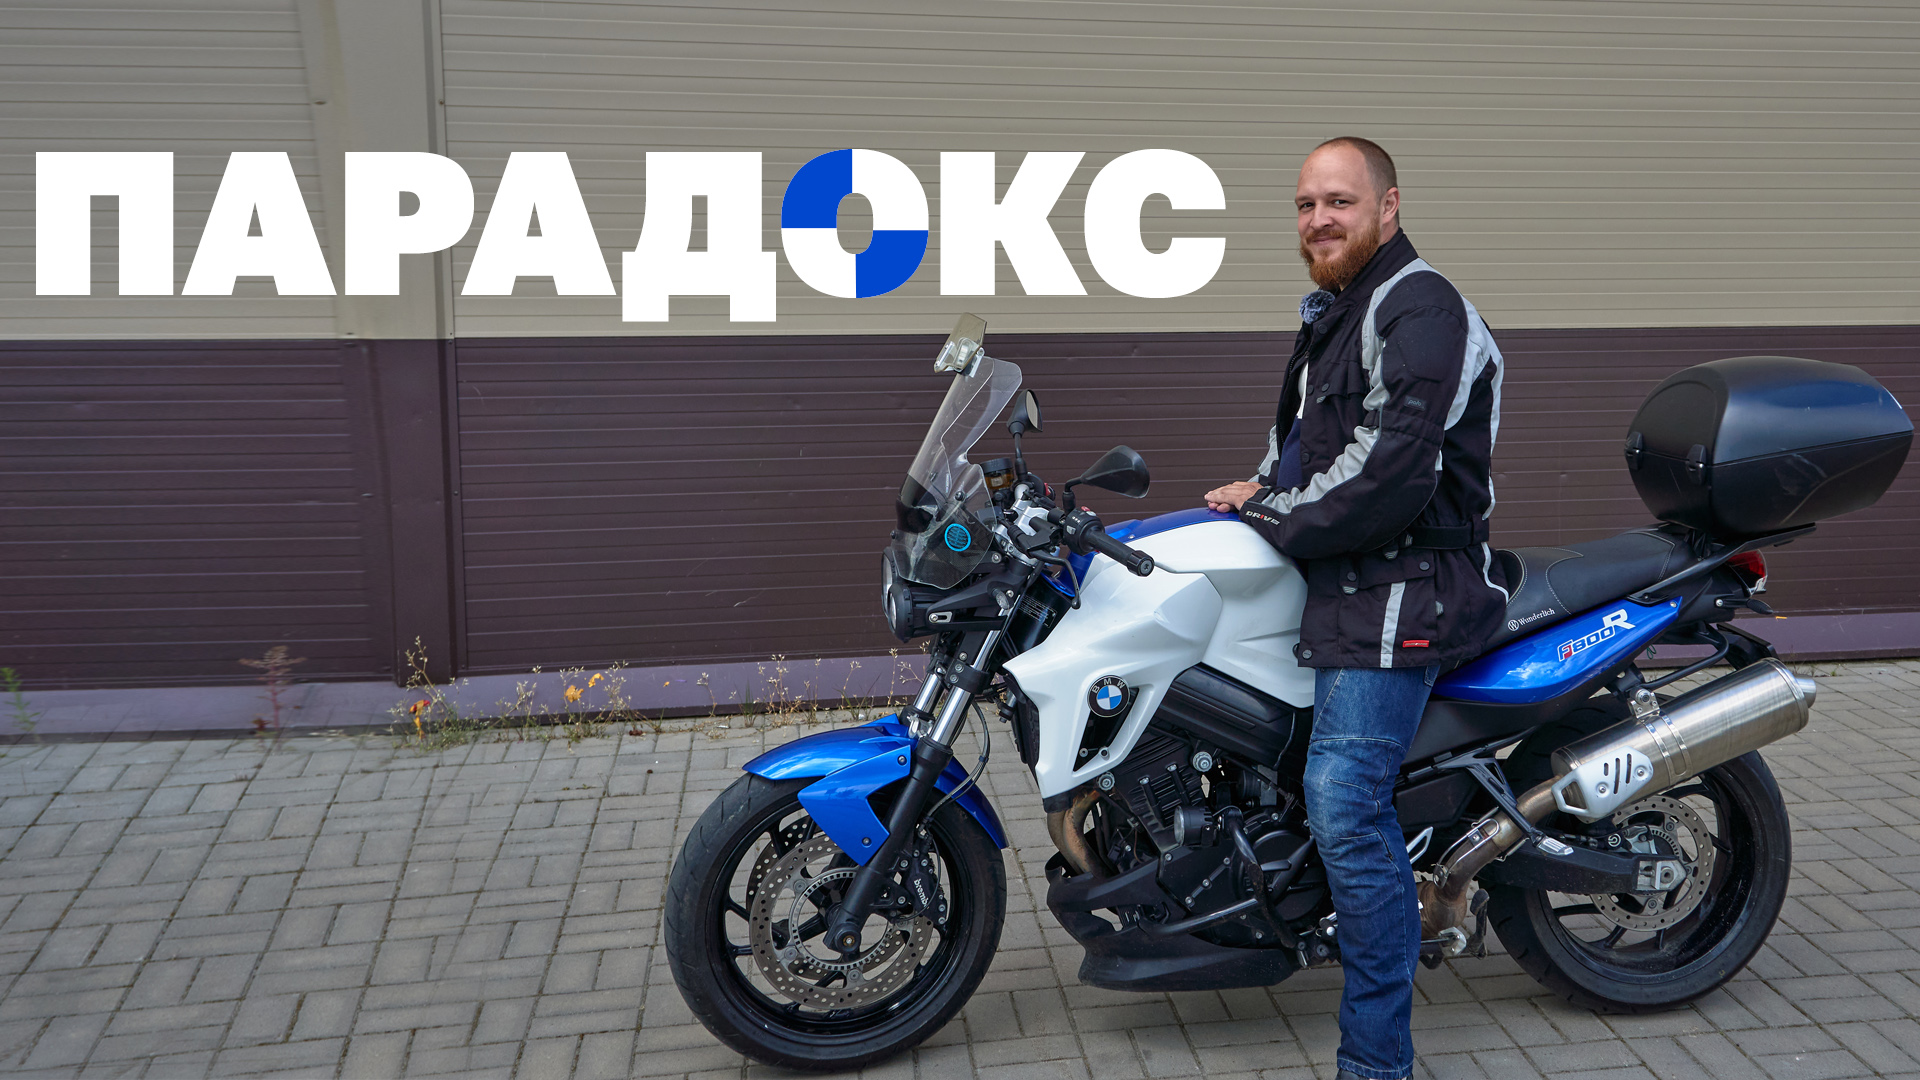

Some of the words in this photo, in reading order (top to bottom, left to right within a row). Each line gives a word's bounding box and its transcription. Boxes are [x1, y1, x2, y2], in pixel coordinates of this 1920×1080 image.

[1245, 510, 1281, 526] DRIVE
[1517, 607, 1556, 626] Wunderlich
[1091, 677, 1126, 694] BMW
